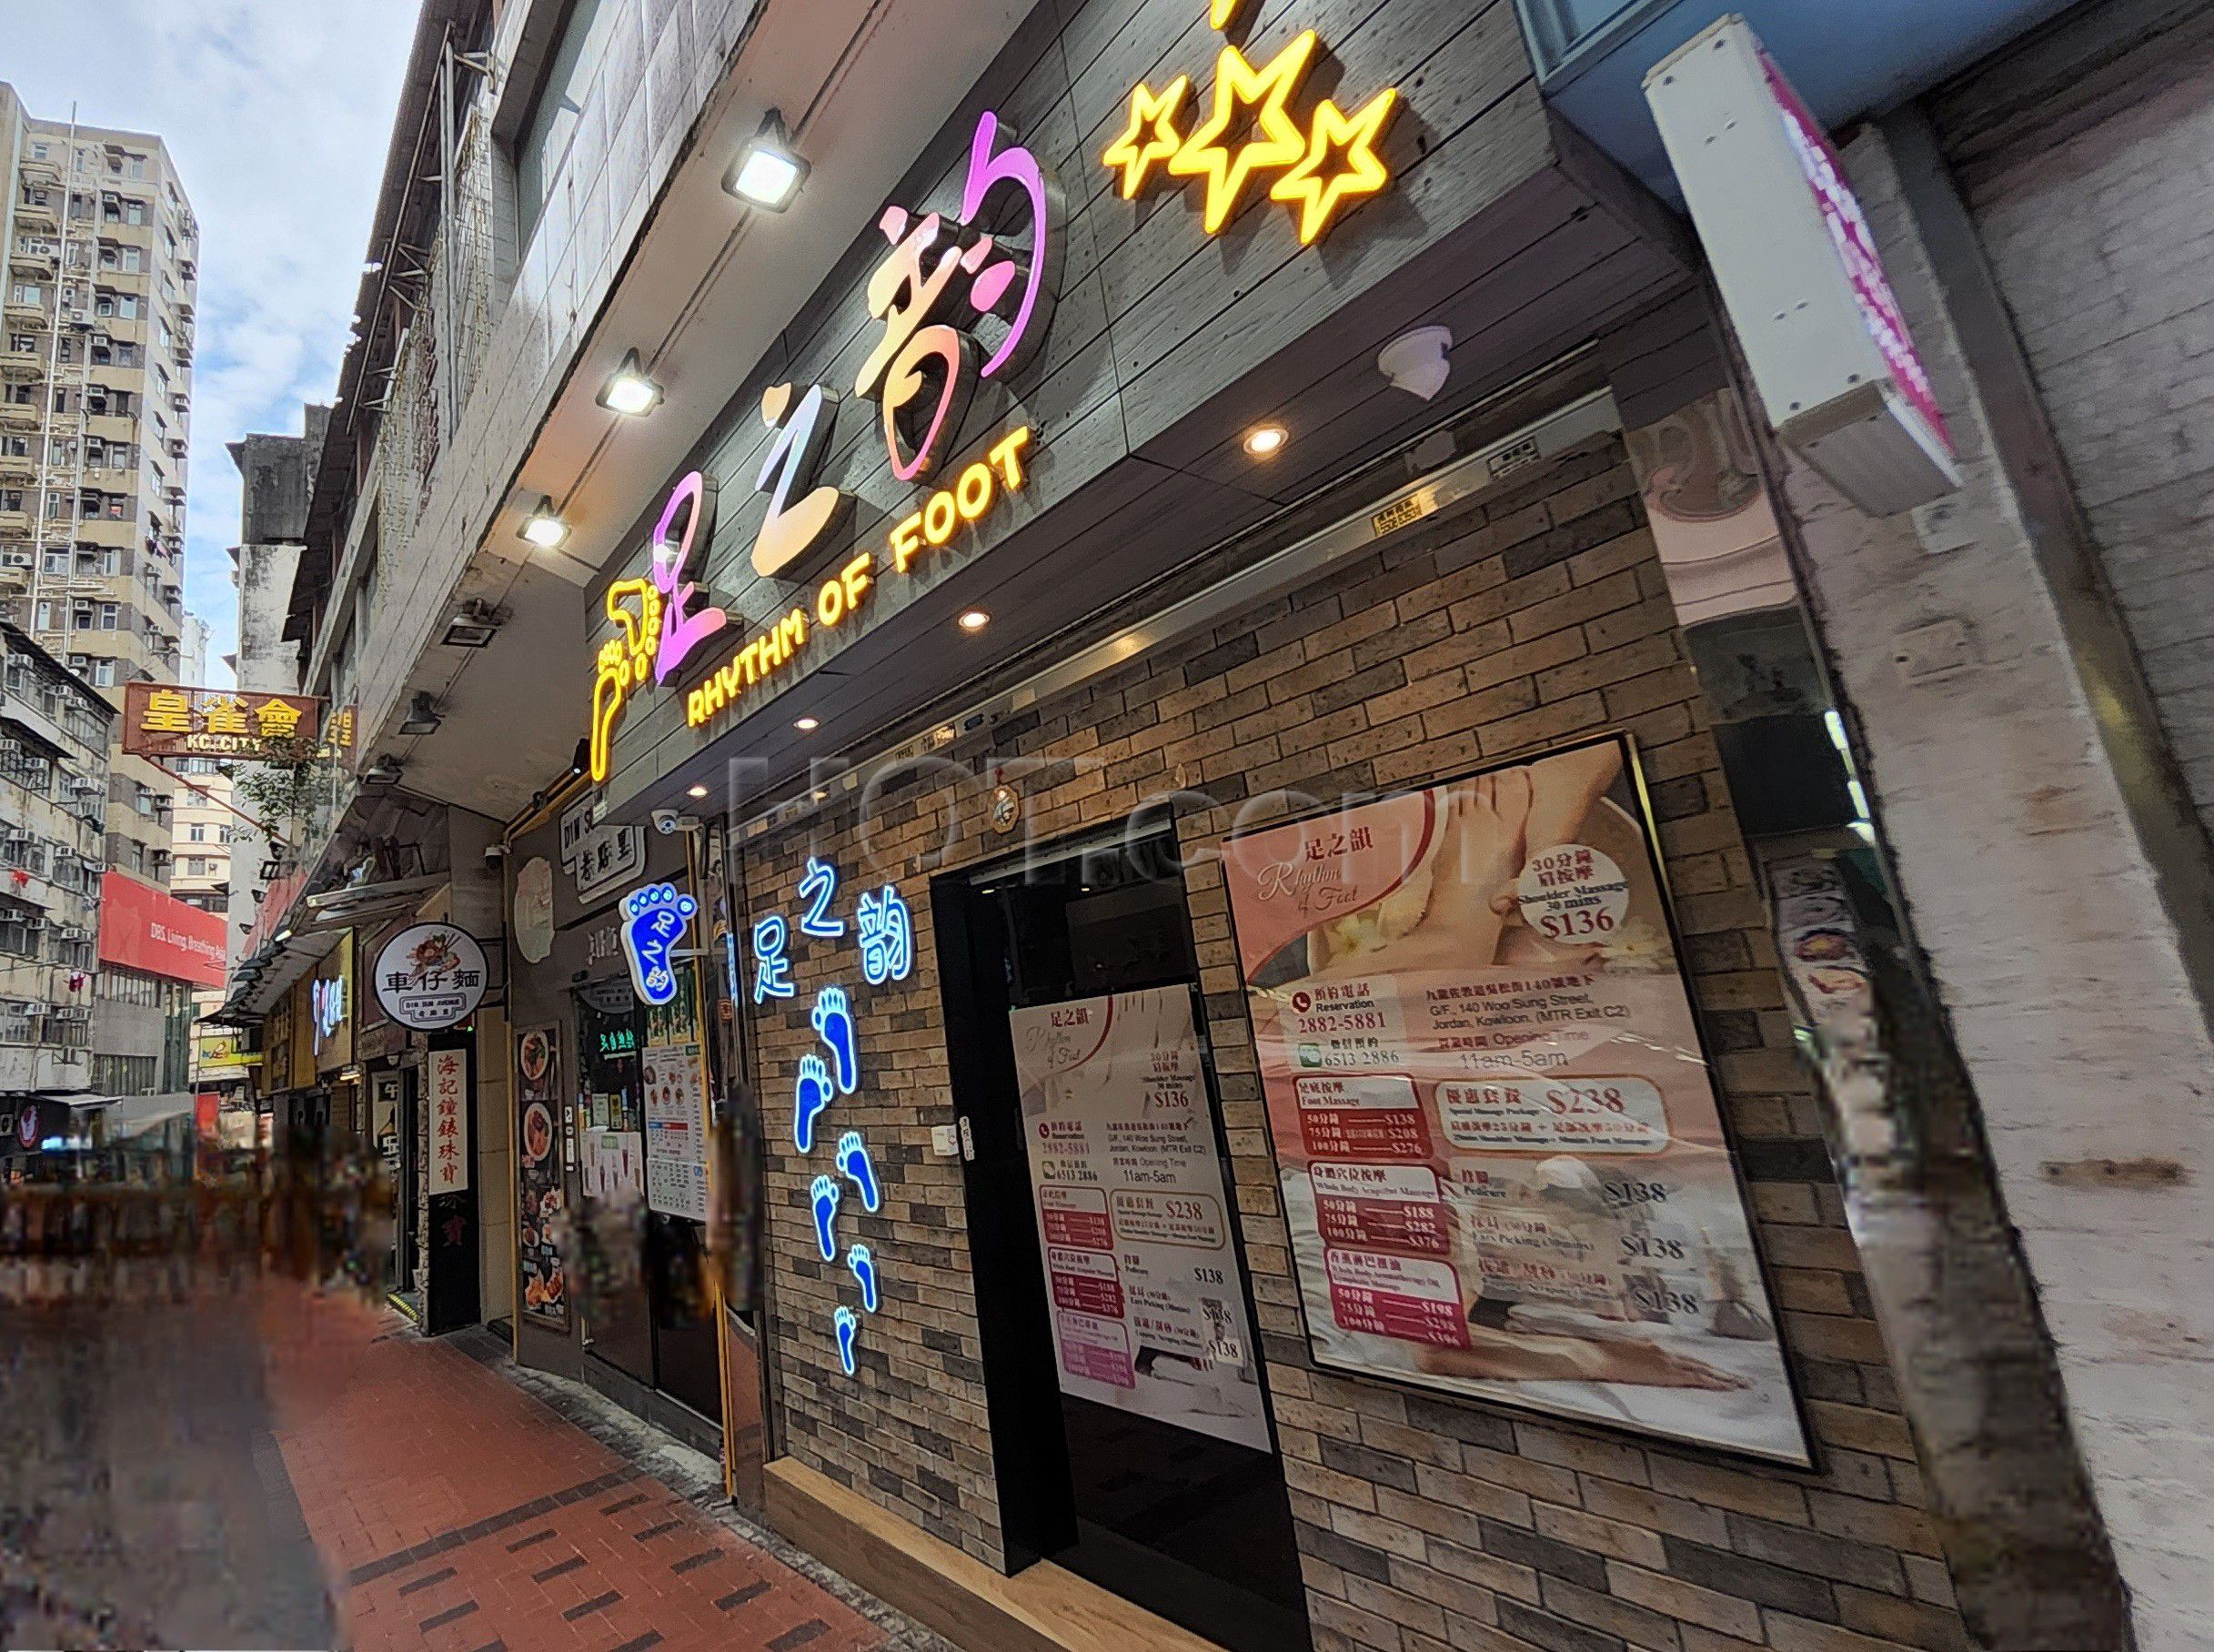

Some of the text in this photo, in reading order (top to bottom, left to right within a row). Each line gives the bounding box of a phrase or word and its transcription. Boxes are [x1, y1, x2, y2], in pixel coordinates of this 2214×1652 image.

[688, 426, 1030, 727] RHYTHM OF FOOT
[1540, 906, 1614, 939] $136
[382, 969, 480, 993] 車仔麵
[1315, 999, 1374, 1013] Reservation
[1297, 1011, 1385, 1034] 2882-5881
[1324, 1049, 1400, 1067] 6513 2886
[1123, 1169, 1176, 1184] 11am-5am
[1165, 1200, 1203, 1221] $238
[1193, 1266, 1224, 1285] $138
